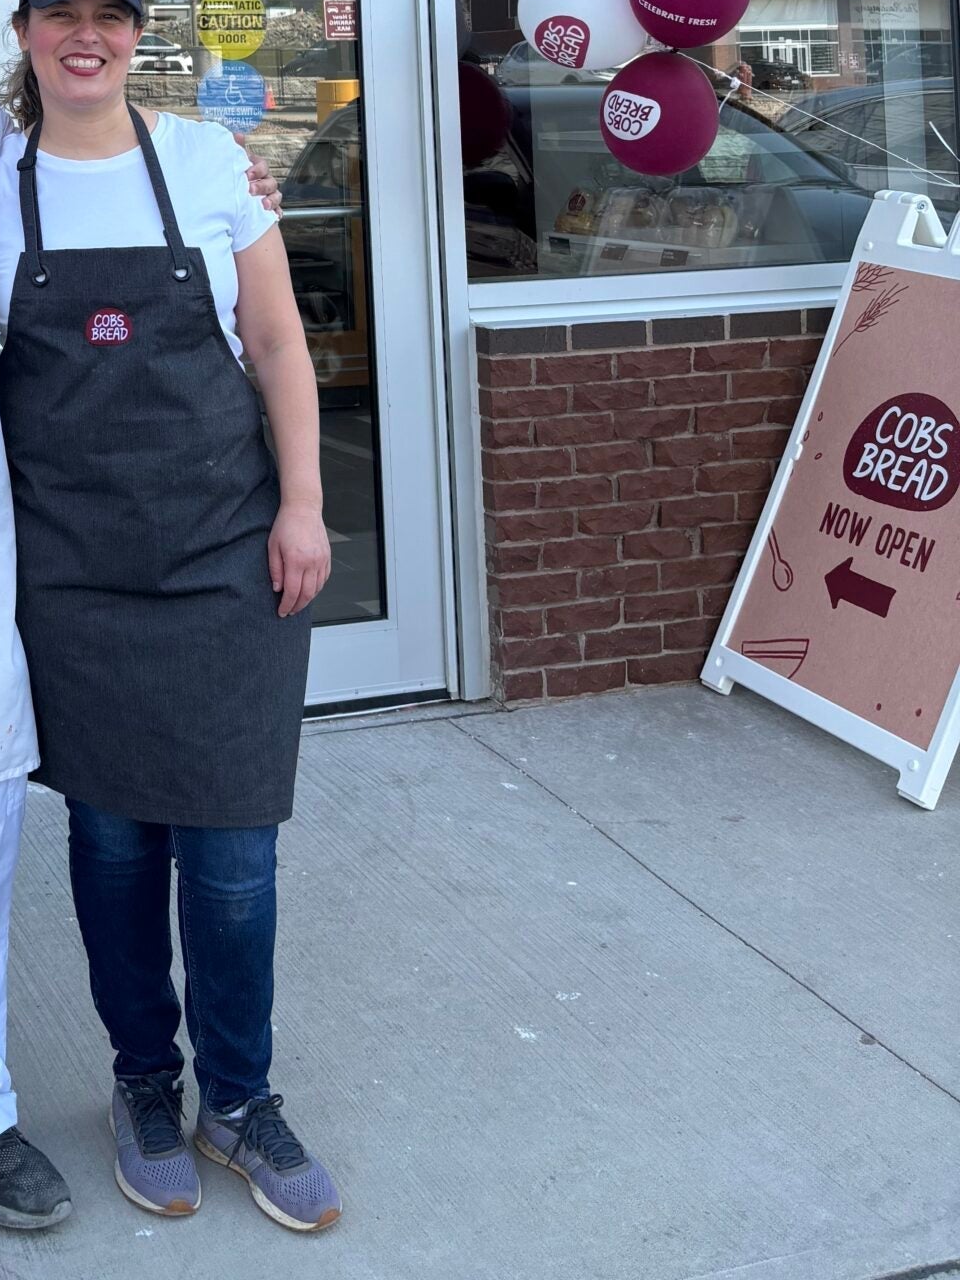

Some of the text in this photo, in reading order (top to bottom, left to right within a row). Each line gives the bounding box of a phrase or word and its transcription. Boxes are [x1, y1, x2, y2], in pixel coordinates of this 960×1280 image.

[202, 0, 261, 10] AUTOMATIC
[200, 15, 263, 29] CAUTION
[688, 17, 718, 27] FRESH
[218, 33, 247, 44] DOOR
[540, 21, 566, 59] COBS
[557, 24, 586, 68] BREAD
[236, 107, 263, 116] SWITCH
[607, 94, 655, 121] BREAD
[607, 111, 643, 136] COBS
[93, 314, 125, 328] COBS
[91, 327, 128, 341] BREAD
[875, 406, 954, 459] COBS
[852, 442, 949, 501] BREAD
[819, 502, 936, 573] NOW OPEN
